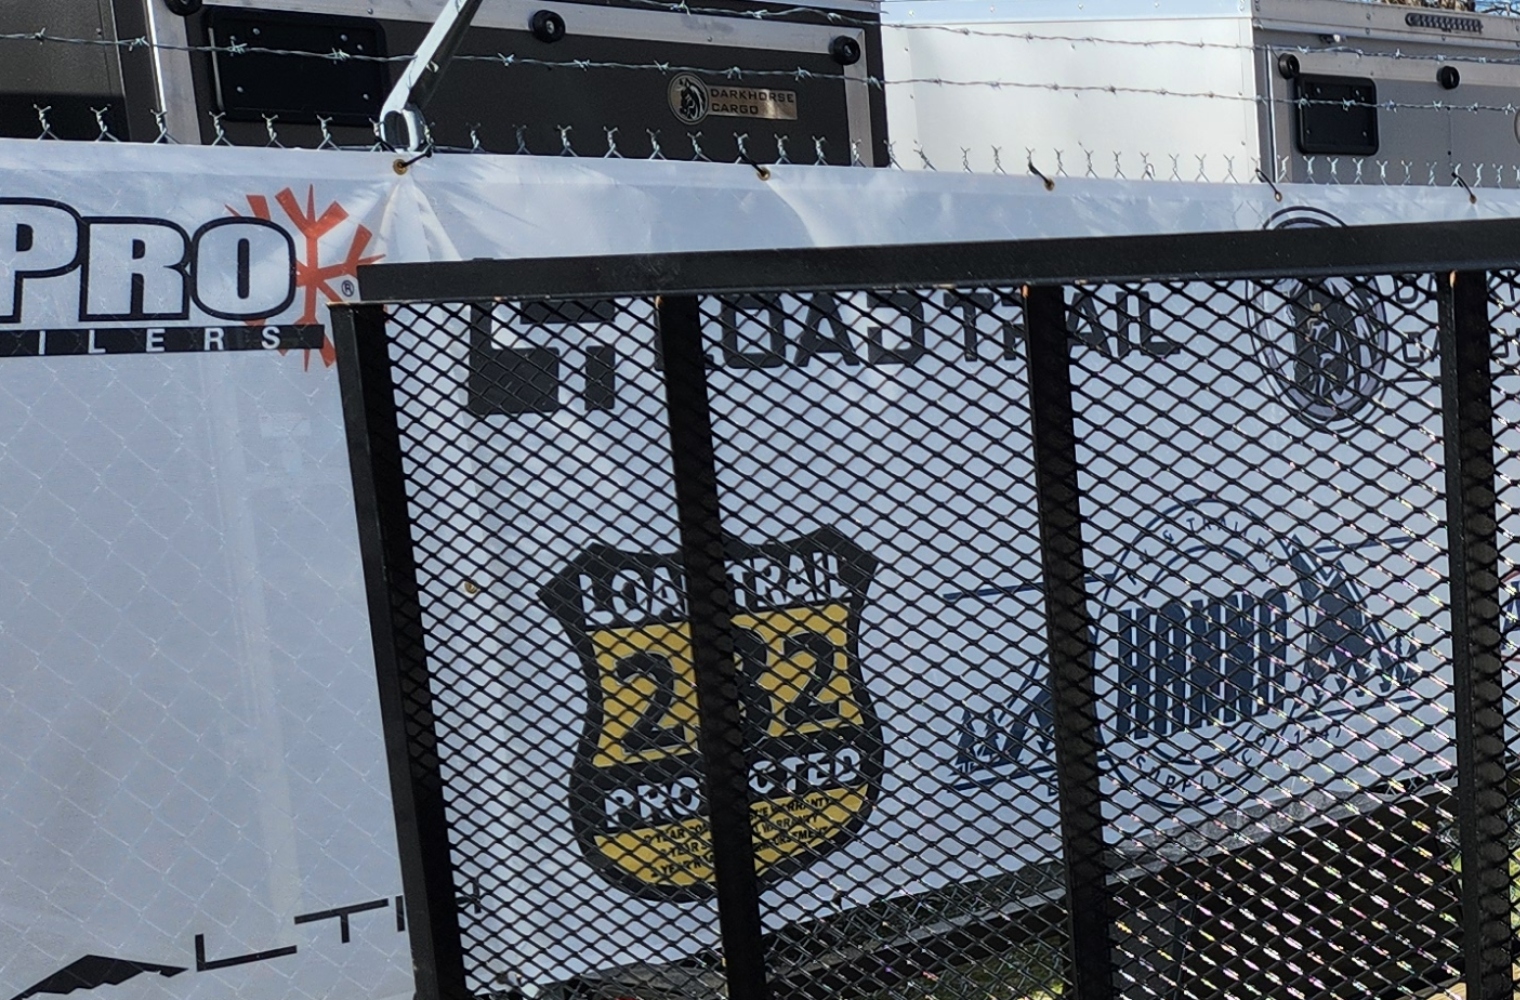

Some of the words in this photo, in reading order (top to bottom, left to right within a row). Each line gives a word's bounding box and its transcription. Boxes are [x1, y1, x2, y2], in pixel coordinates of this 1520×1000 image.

[709, 87, 795, 103] DARKHORSE
[710, 102, 760, 115] CARGO
[0, 196, 297, 324] PRO
[579, 560, 692, 627] LOA
[604, 747, 862, 829] PROCTED
